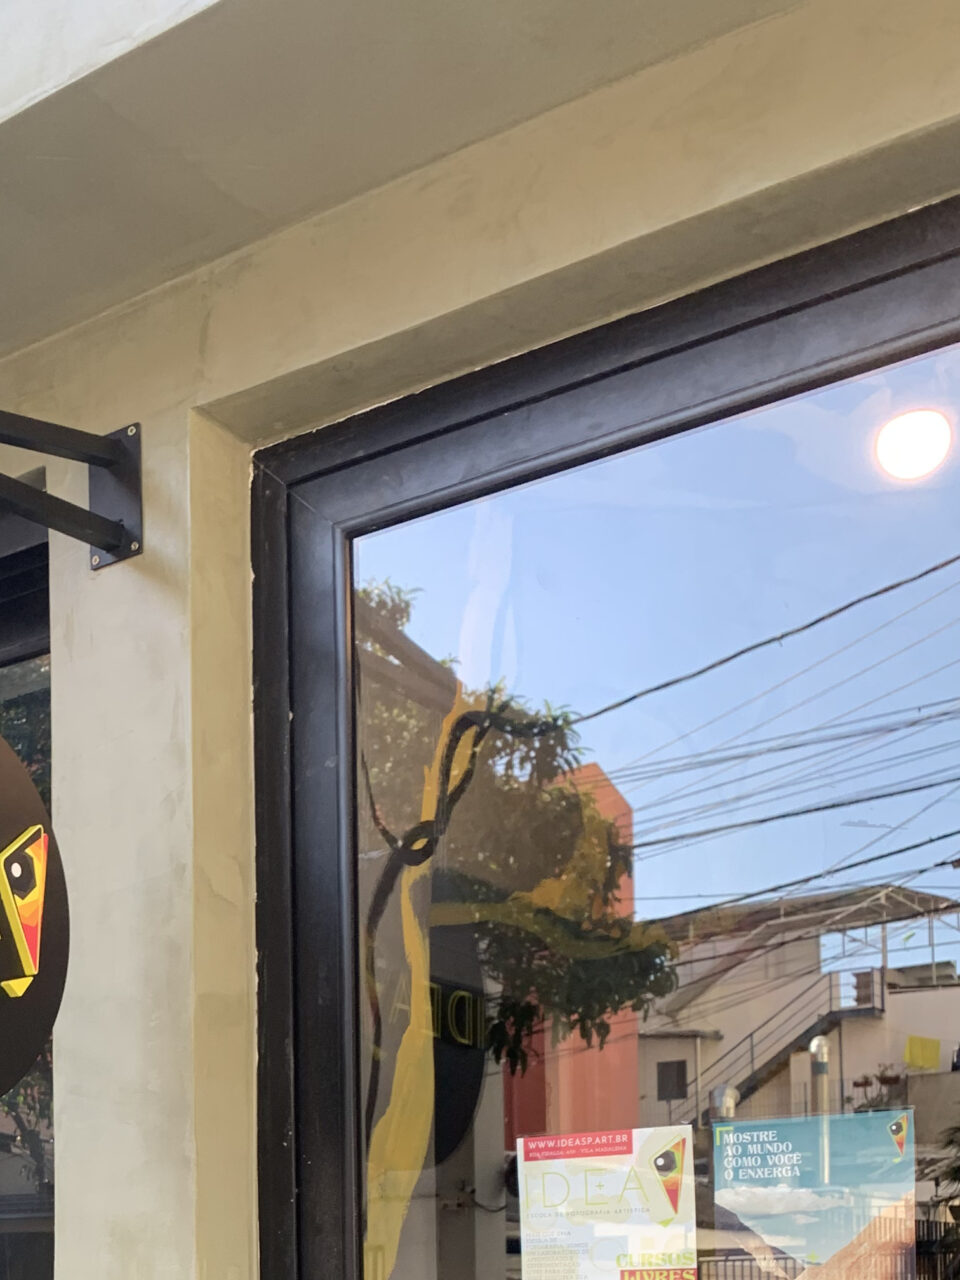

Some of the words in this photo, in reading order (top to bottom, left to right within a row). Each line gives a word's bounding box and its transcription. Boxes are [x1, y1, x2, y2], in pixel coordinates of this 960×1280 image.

[528, 1134, 628, 1149] WWW.IDEASP.ART.BR
[723, 1130, 778, 1145] MOSTRE
[724, 1144, 743, 1157] AO
[747, 1141, 793, 1155] MUNDO
[723, 1155, 762, 1169] COMO
[766, 1152, 802, 1166] VOCÊ
[724, 1168, 734, 1181] O
[739, 1165, 801, 1180] ENXERGA
[524, 1165, 651, 1210] IDEA
[615, 1251, 695, 1269] CURSOS
